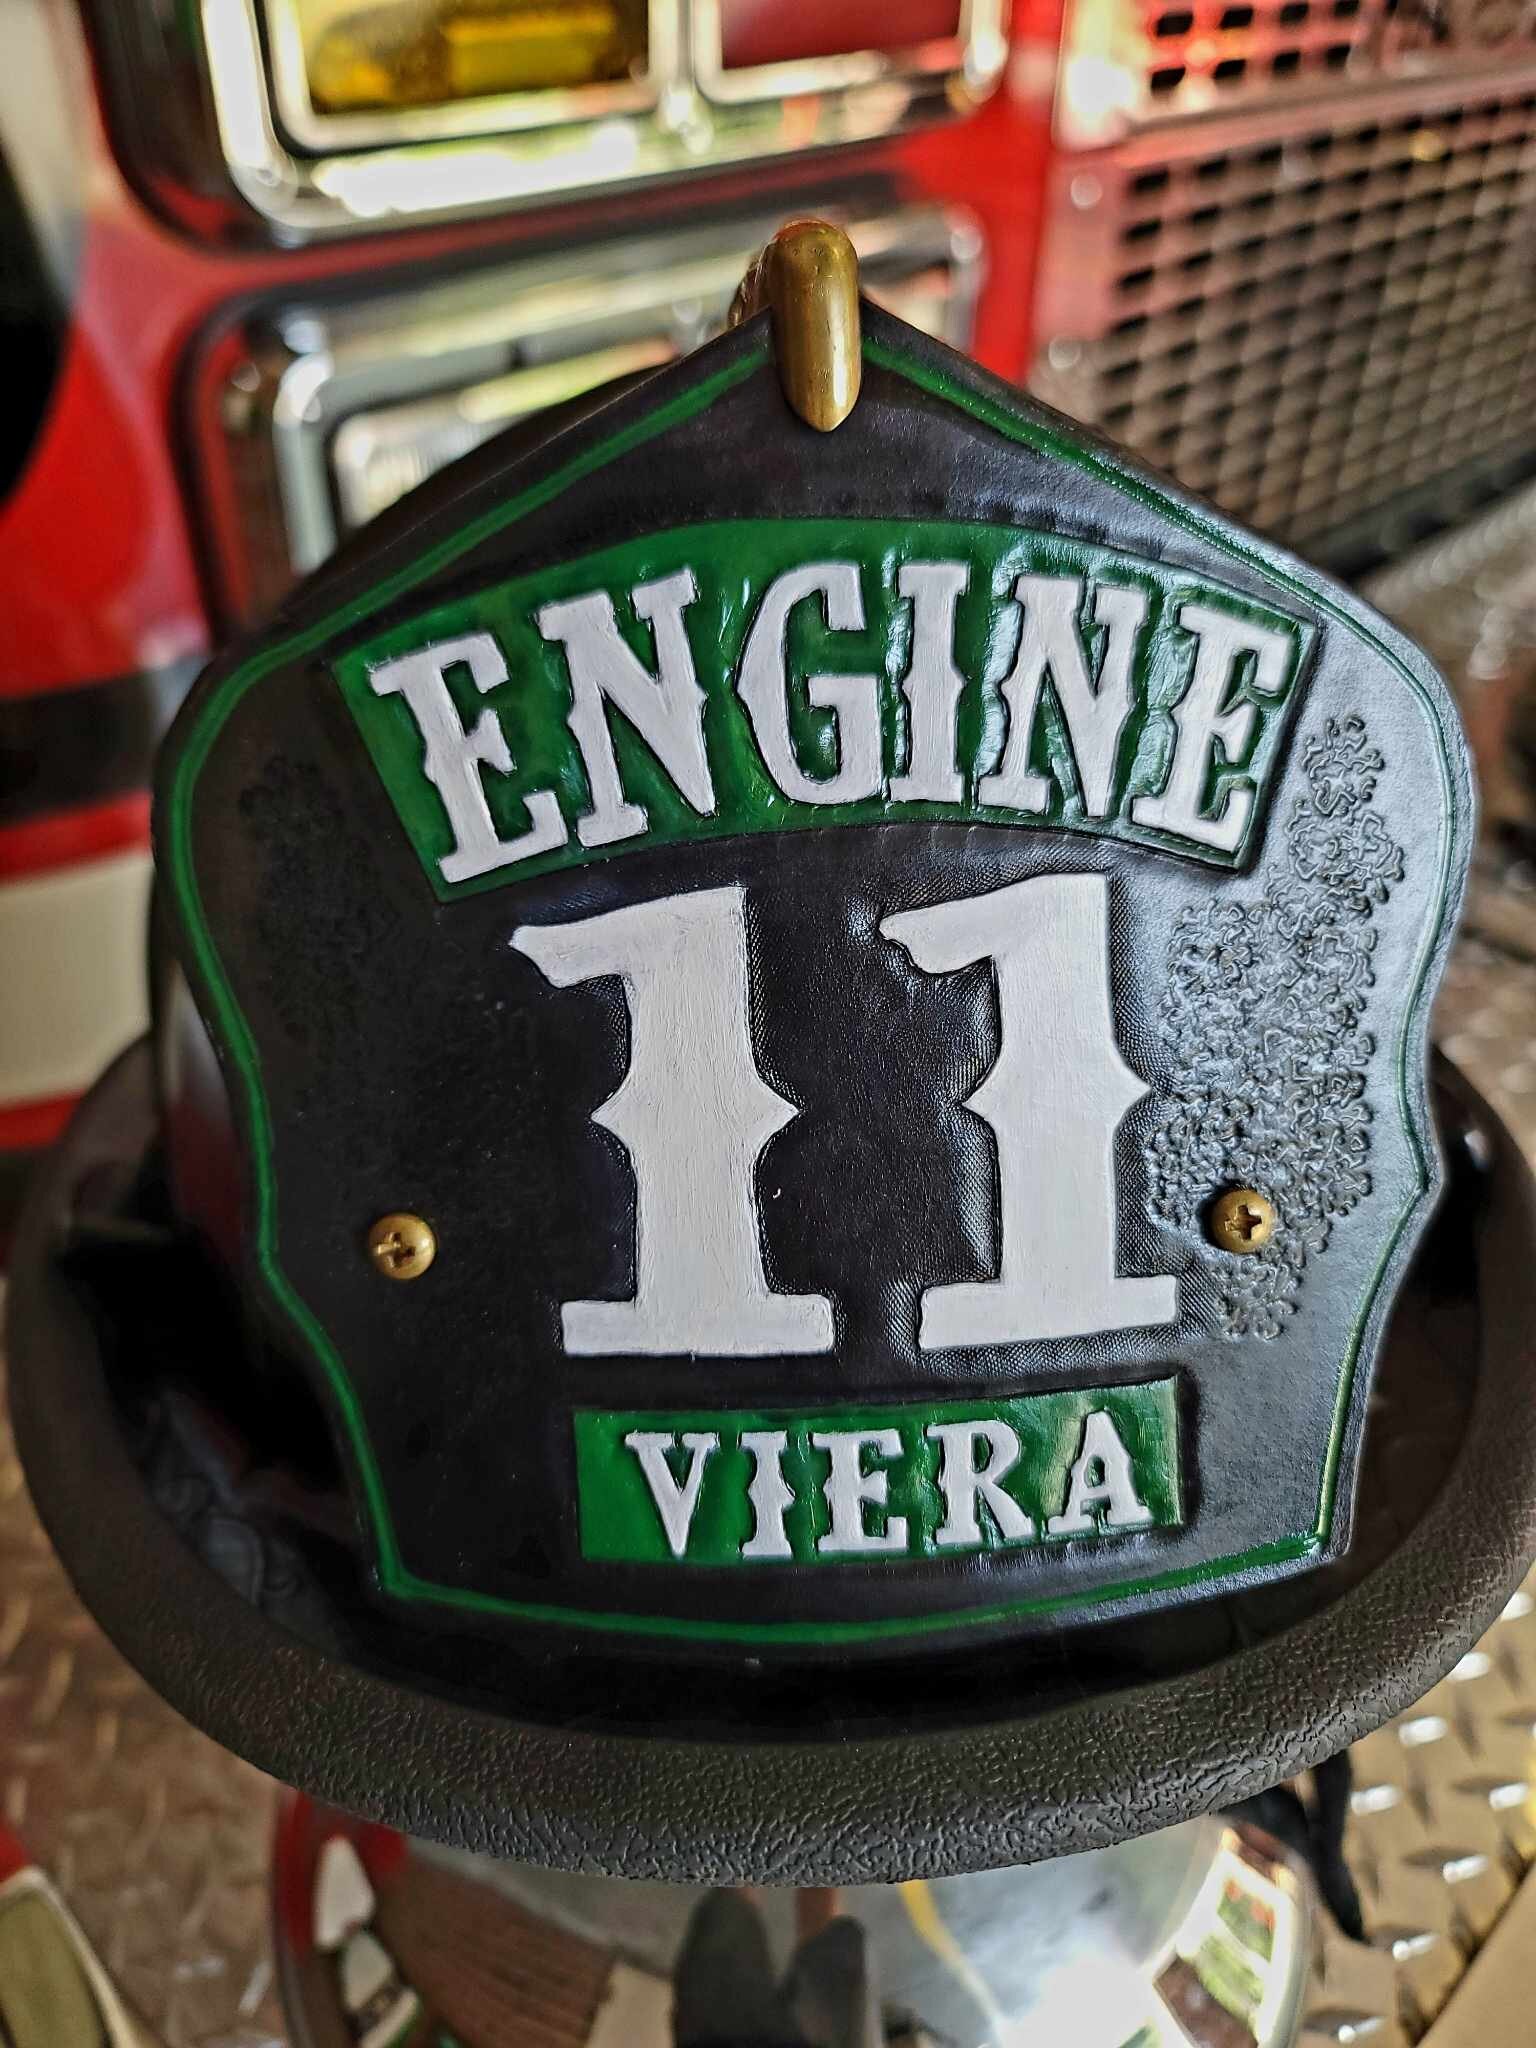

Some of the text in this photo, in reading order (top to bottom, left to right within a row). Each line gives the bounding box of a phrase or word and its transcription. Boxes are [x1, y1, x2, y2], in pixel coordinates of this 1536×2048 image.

[368, 561, 1291, 883] ENGINE
[510, 874, 1178, 1357] 11
[625, 1411, 1150, 1558] VIERA
